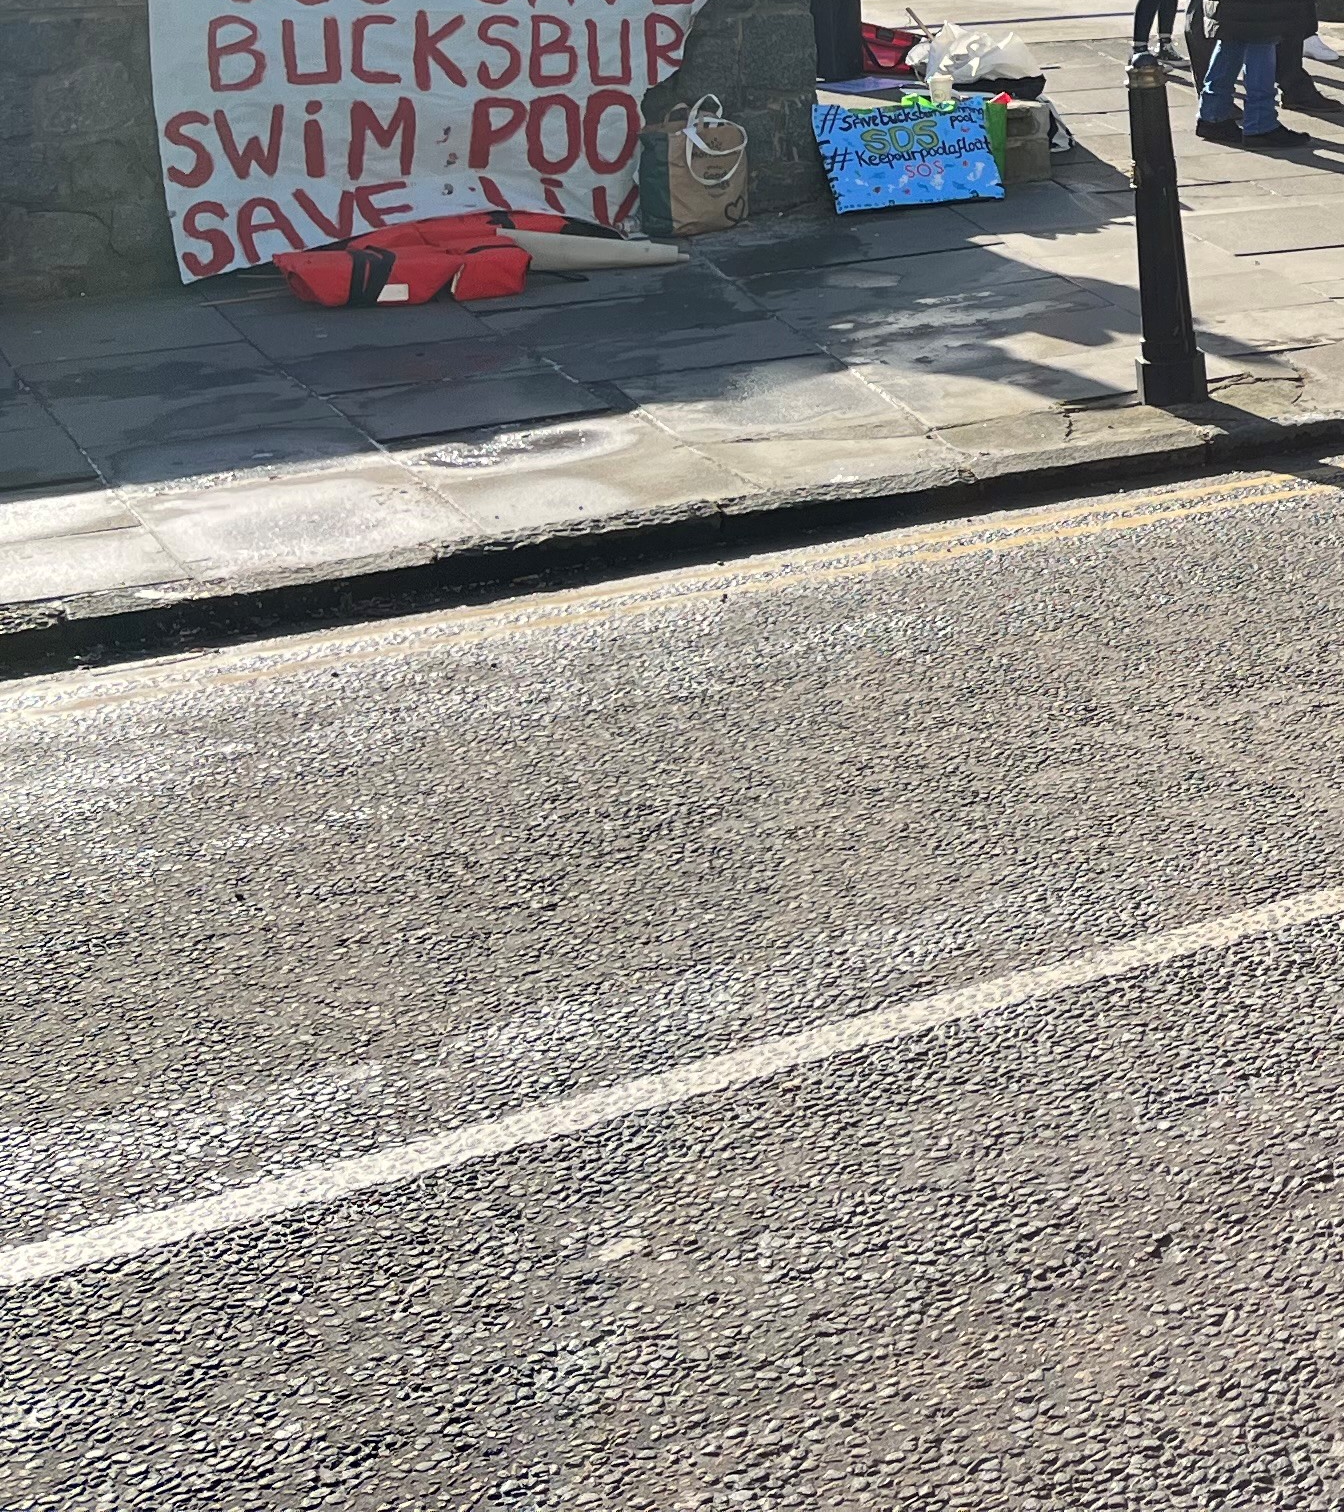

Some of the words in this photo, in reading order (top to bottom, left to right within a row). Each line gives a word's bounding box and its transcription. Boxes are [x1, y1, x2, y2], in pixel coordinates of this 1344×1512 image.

[206, 9, 685, 93] BUCKSBUR
[467, 88, 642, 176] POO
[860, 119, 940, 157] SOS
[904, 159, 945, 179] SOS
[181, 180, 415, 278] SAVE
